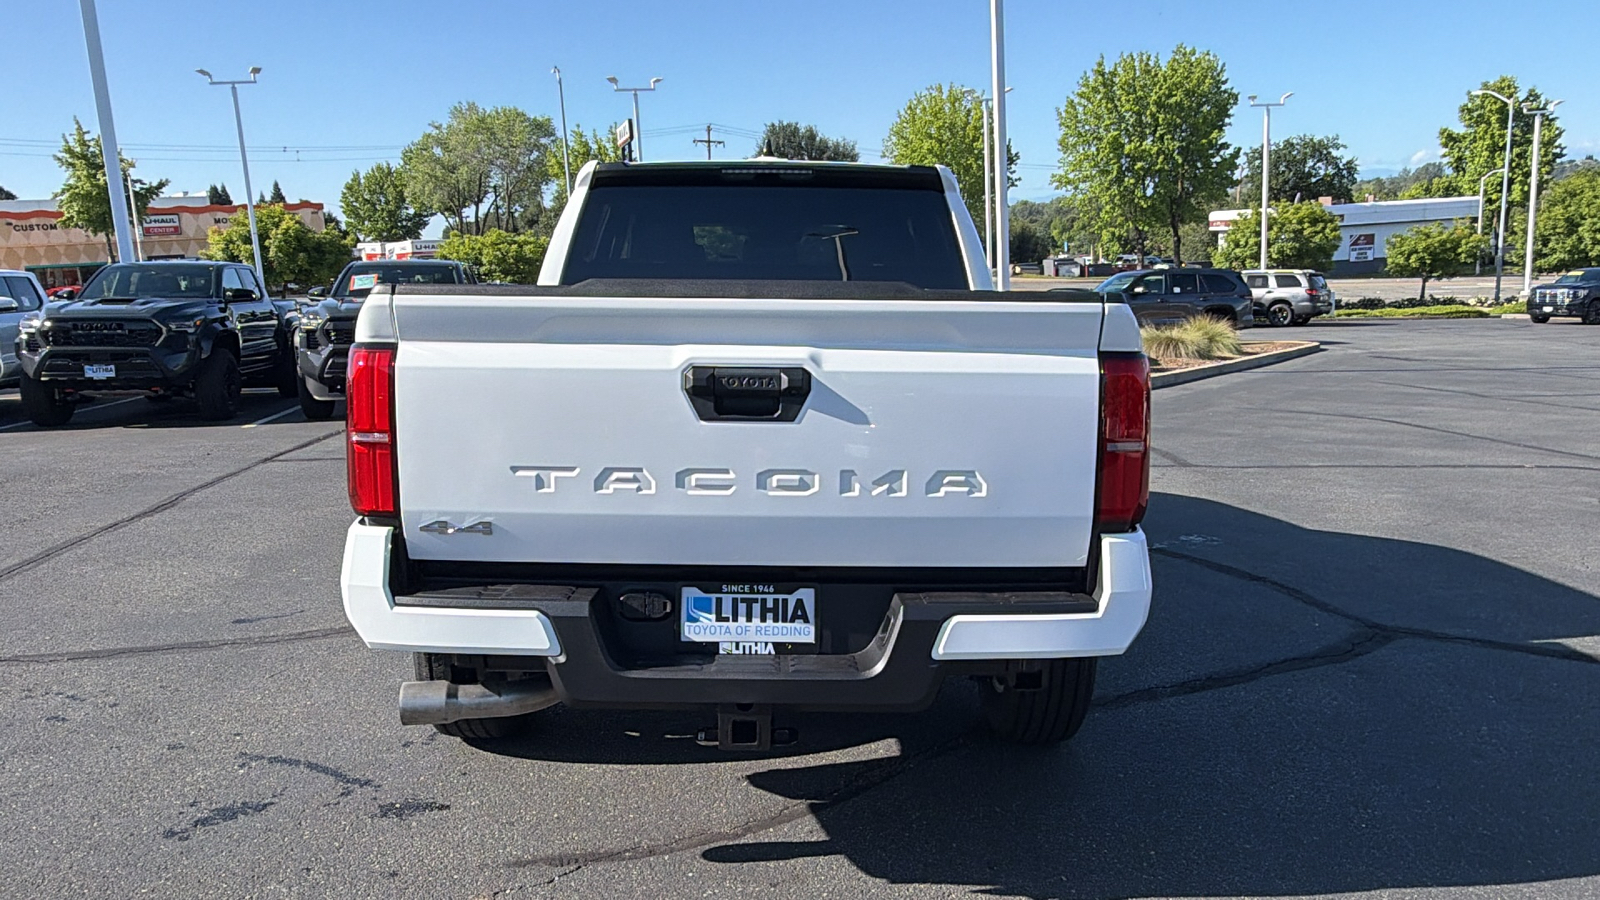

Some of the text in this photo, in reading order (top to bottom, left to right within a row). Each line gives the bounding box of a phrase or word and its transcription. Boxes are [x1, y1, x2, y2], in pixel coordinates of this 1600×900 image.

[13, 223, 58, 232] CUSTOM
[74, 322, 122, 331] TOYOTA
[719, 377, 778, 389] TOYOTA
[510, 465, 989, 498] TACOMA
[721, 584, 774, 593] SINCE 1946
[715, 596, 810, 624] LITHIA
[686, 624, 811, 637] TOYOTA OF REDDING
[732, 642, 775, 655] LITHIA
